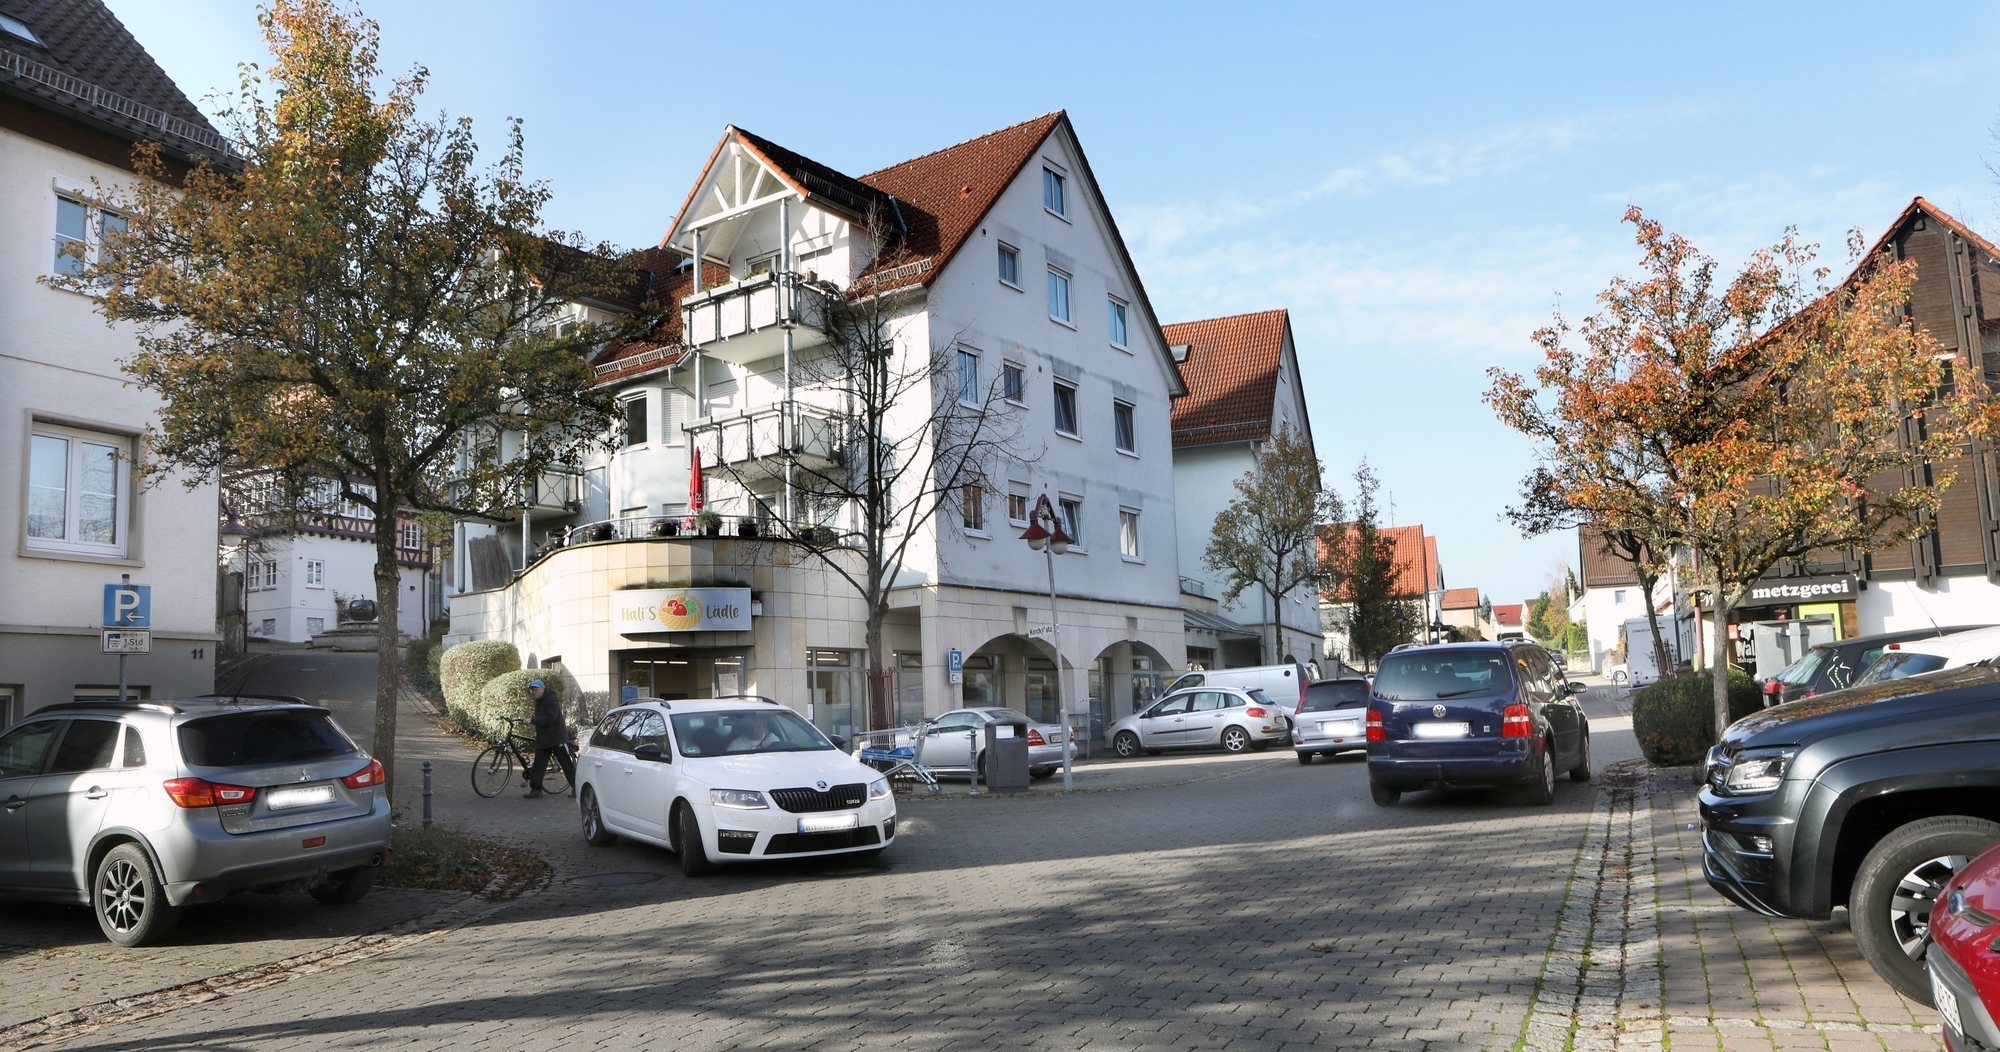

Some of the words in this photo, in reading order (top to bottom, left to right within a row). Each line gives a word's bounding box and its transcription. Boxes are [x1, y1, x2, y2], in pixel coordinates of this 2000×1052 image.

[1752, 579, 1849, 598] metzgerei
[114, 589, 141, 622] P
[706, 604, 739, 620] Lädle
[191, 648, 204, 660] 11
